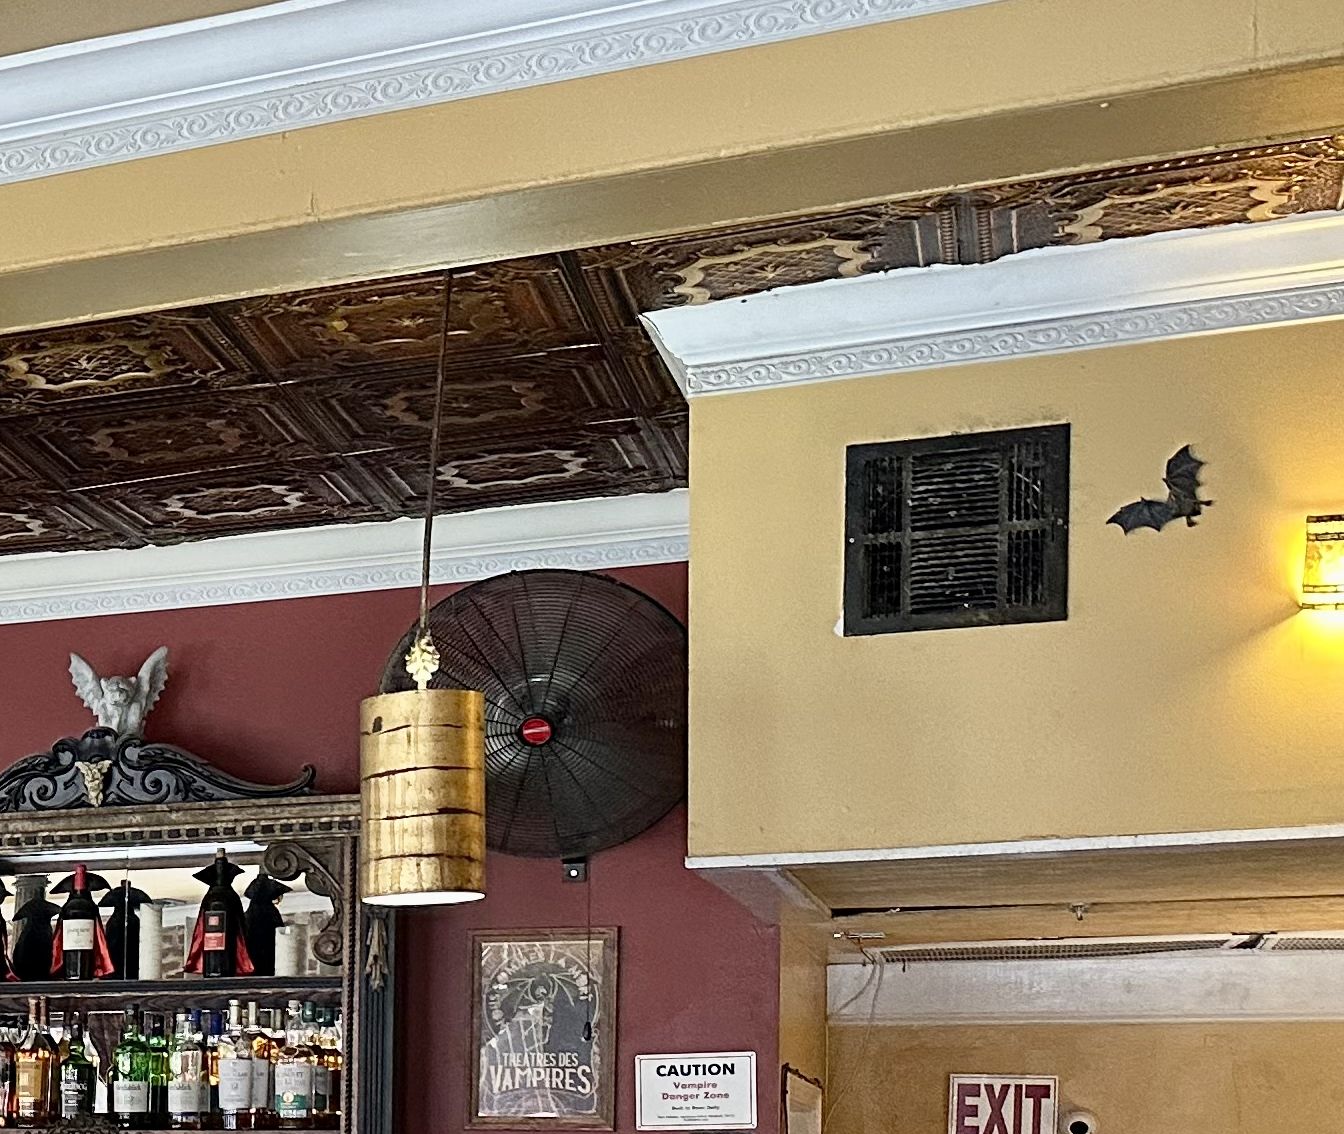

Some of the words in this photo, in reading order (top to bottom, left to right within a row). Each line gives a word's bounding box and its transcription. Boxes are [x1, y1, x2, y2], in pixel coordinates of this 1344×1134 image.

[559, 1052, 579, 1067] DES
[656, 1063, 735, 1077] CAUTION
[489, 1065, 592, 1094] VAMPIRES
[673, 1081, 718, 1090] Vampire
[661, 1093, 700, 1101] Danger
[703, 1092, 730, 1100] Zone
